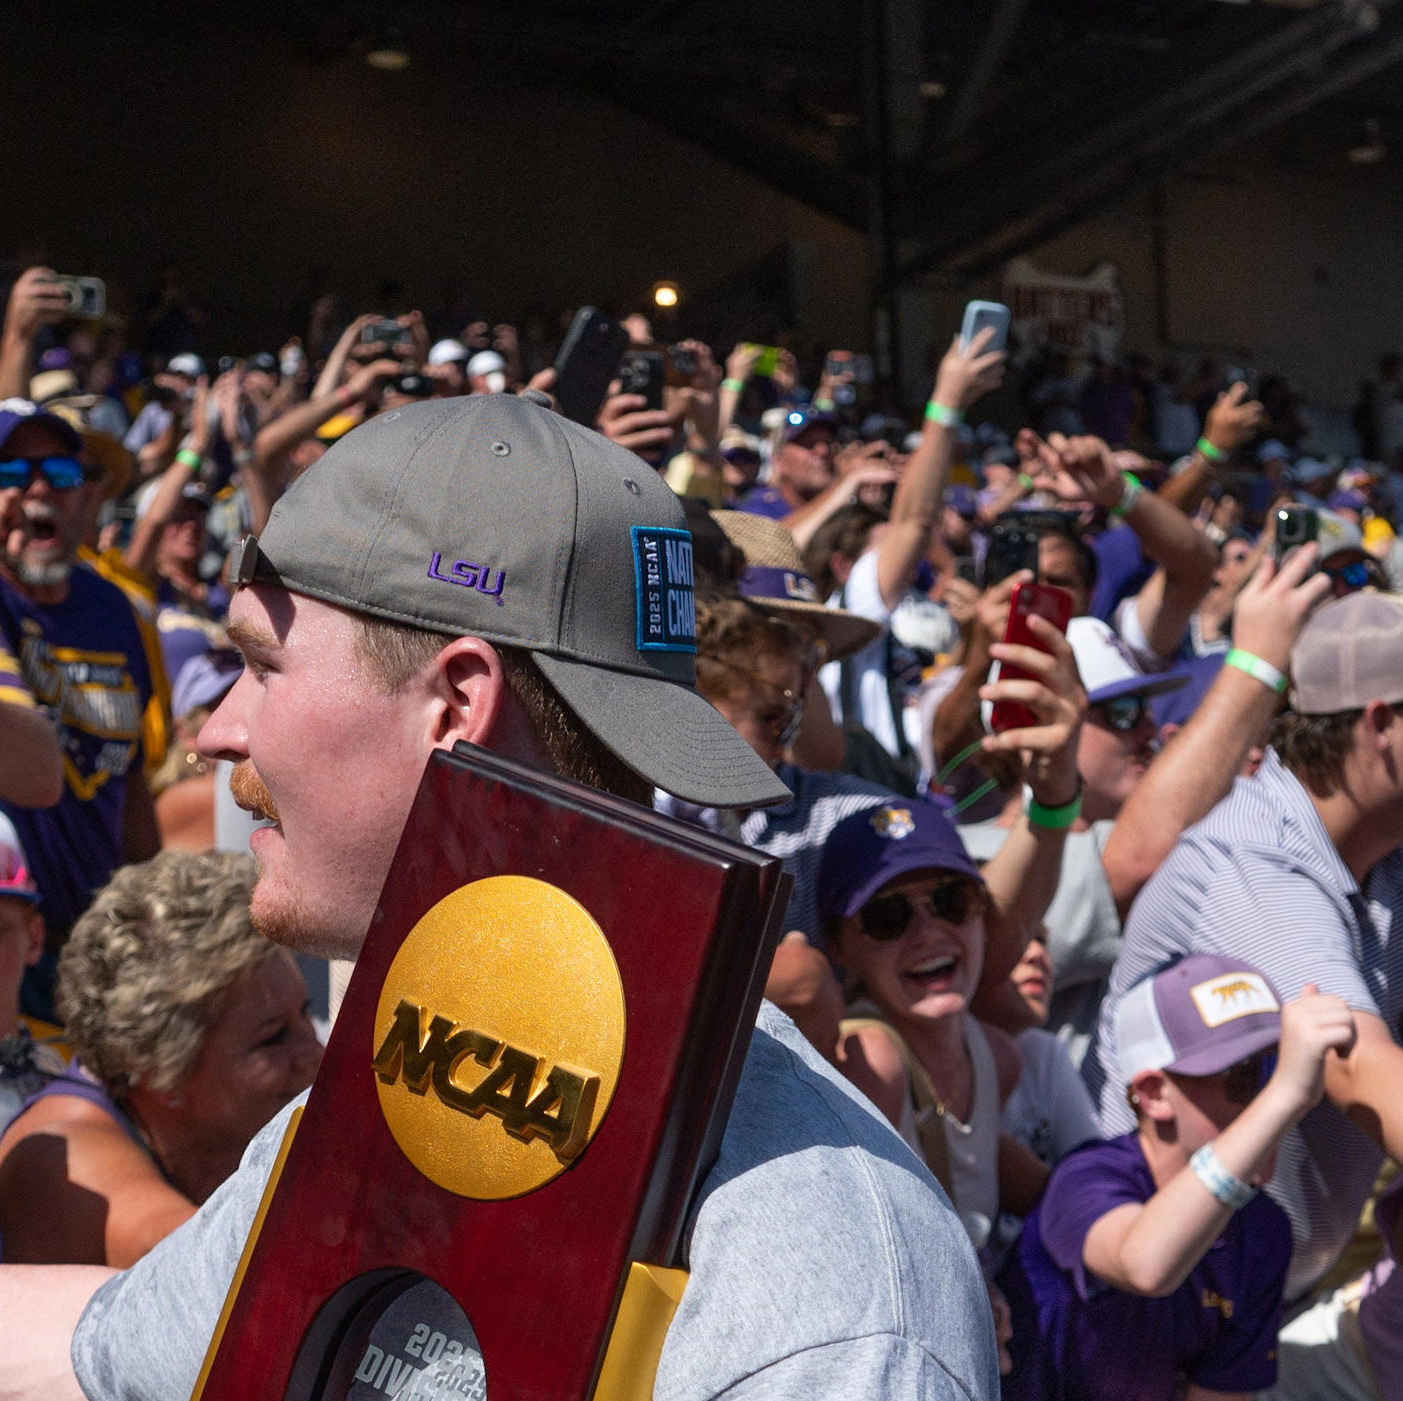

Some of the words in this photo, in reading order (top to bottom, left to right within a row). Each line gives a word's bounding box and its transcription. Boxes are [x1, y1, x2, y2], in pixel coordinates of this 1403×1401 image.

[427, 551, 505, 597] LSU
[643, 540, 660, 586] NCAA
[665, 539, 695, 587] NATI
[649, 592, 662, 634] 2025
[370, 1000, 601, 1168] NCAA
[404, 1323, 483, 1371] 2025
